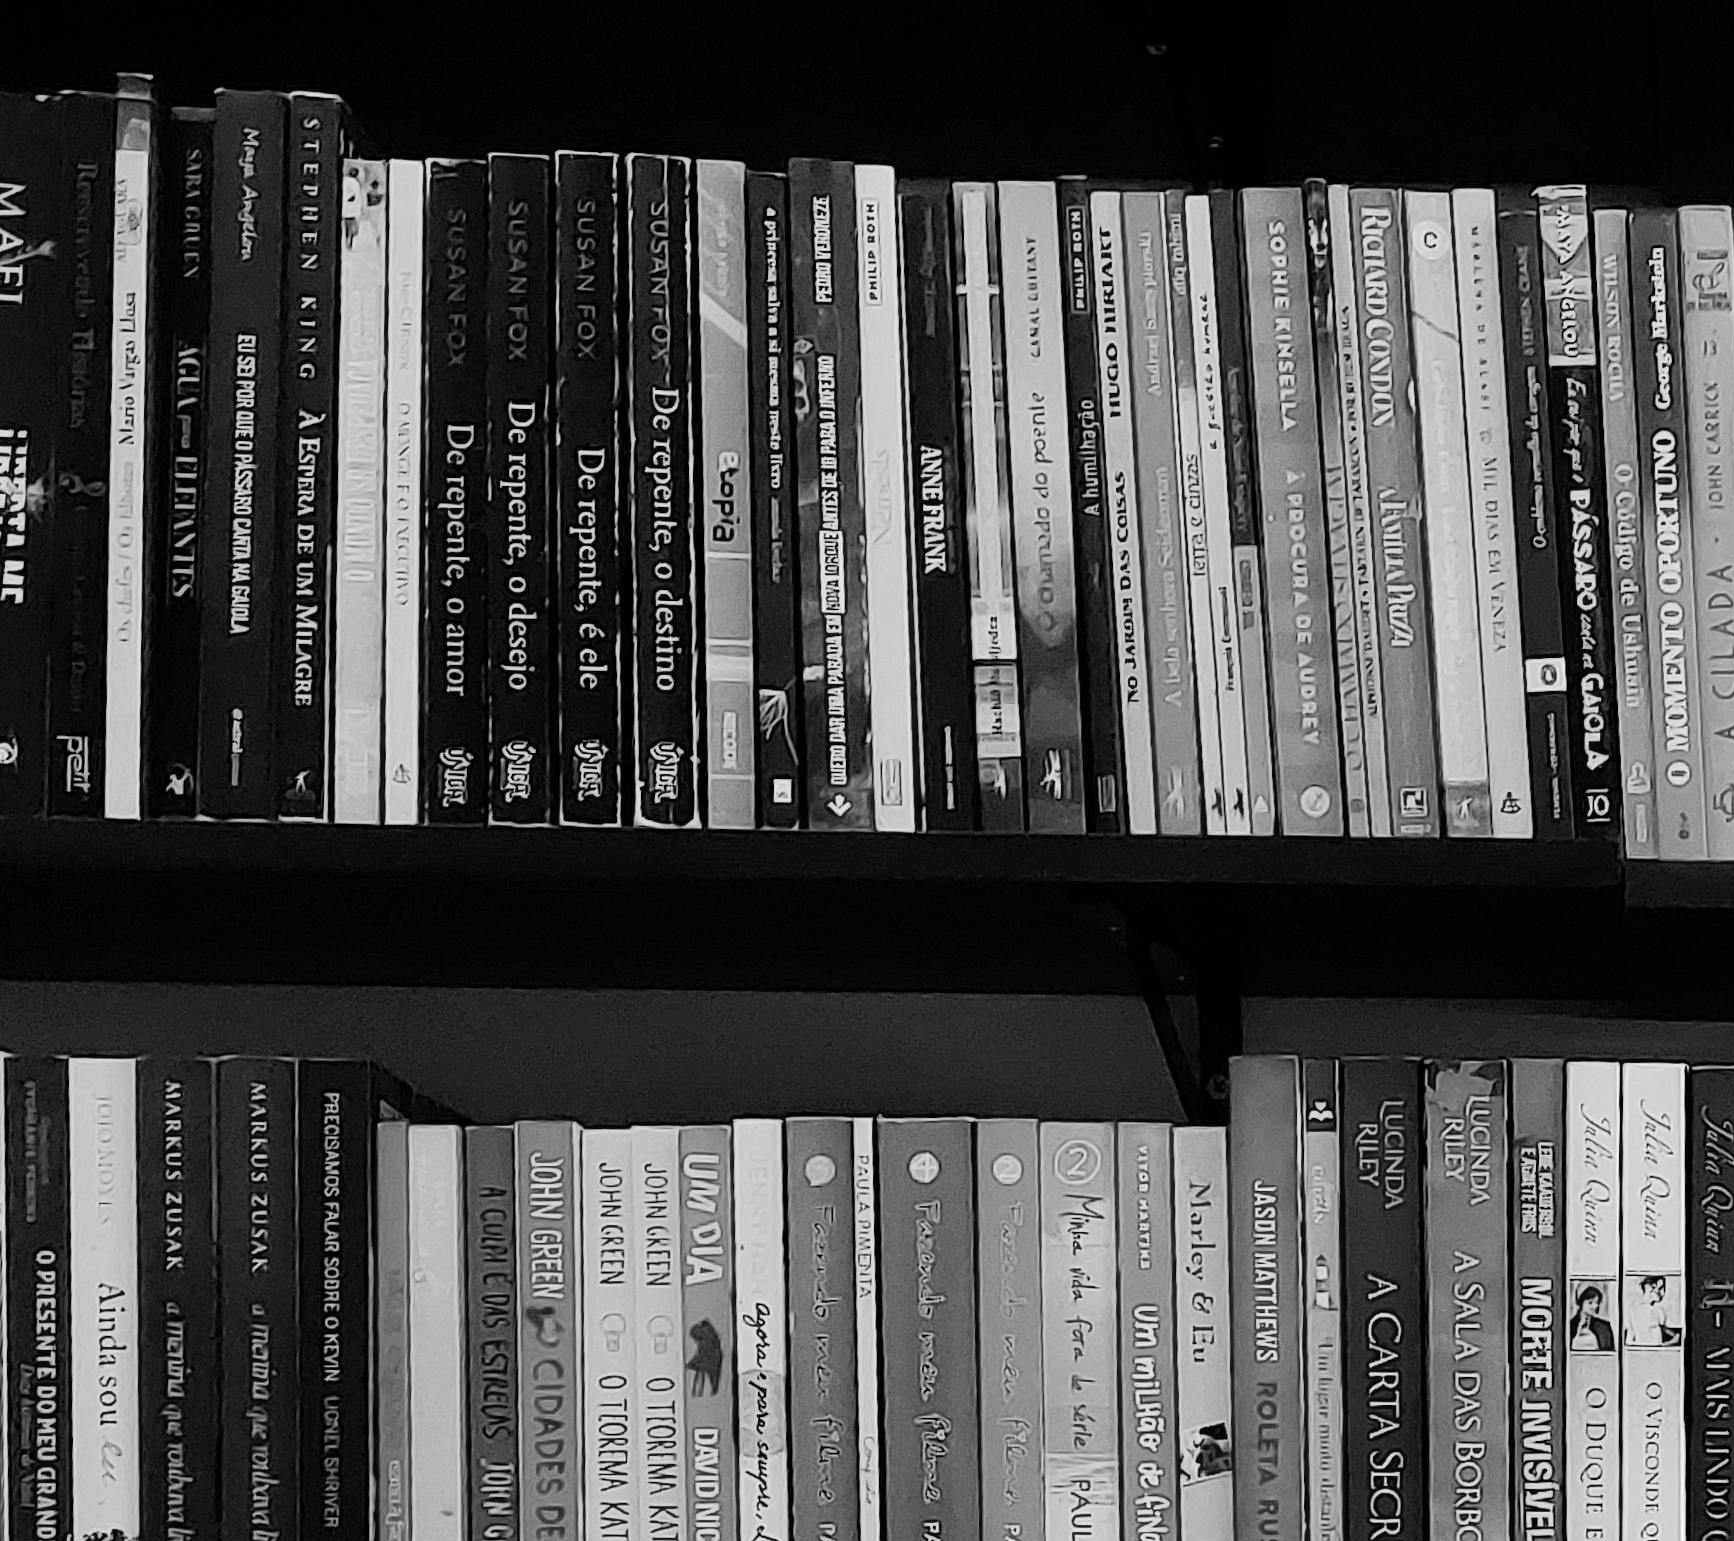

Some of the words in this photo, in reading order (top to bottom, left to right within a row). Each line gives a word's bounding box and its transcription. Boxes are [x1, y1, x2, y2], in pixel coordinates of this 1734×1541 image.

[1269, 223, 1289, 309] SOPHIE
[300, 297, 316, 377] KING
[578, 449, 605, 489] De
[921, 446, 943, 500] ANNE
[570, 500, 601, 611] repente,
[923, 504, 946, 573] FRANK
[579, 624, 605, 638] é
[579, 649, 608, 688] ele
[166, 1082, 181, 1179] MARKUS
[166, 1193, 182, 1269] ZUSAK
[1186, 1184, 1216, 1280] Marley
[1254, 1181, 1276, 1244] JASON
[36, 1251, 55, 1264] O
[36, 1271, 56, 1378] PRESENTE
[1192, 1293, 1213, 1313] &
[1255, 1254, 1278, 1360] MATTHEWS
[1522, 1280, 1552, 1391] MORTE
[1193, 1326, 1214, 1362] Eu
[37, 1386, 56, 1413] DO
[37, 1418, 56, 1460] MEU
[695, 1429, 719, 1497] DAVID
